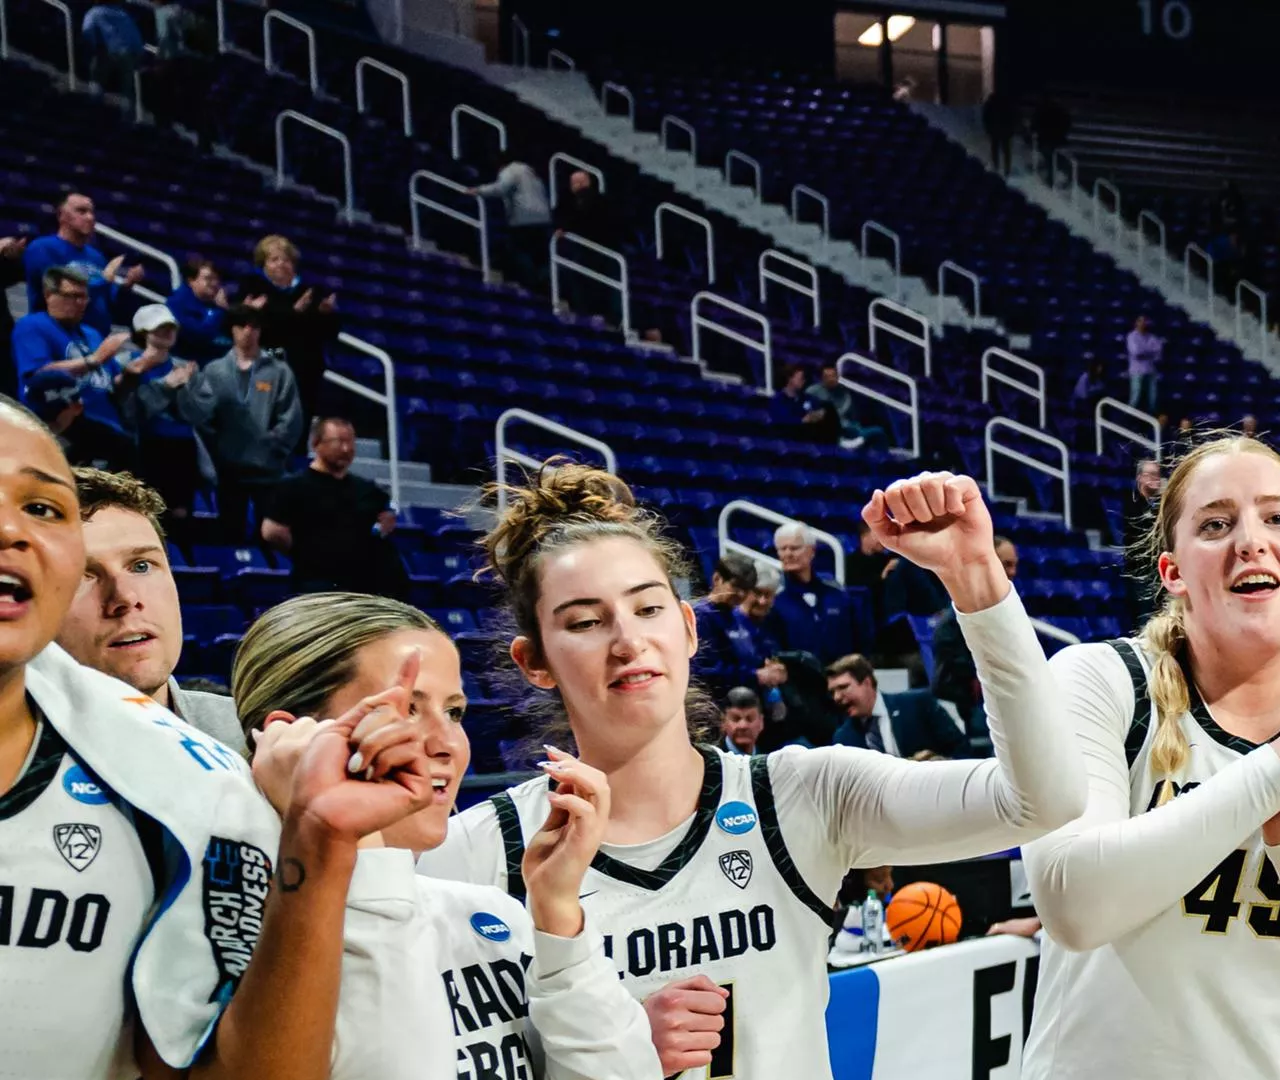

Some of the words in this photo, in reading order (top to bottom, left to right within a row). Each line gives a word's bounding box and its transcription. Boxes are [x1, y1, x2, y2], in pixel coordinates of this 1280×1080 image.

[1138, 0, 1192, 39] 10
[723, 815, 757, 829] NCAA
[66, 845, 88, 860] 12
[730, 865, 747, 881] 12
[209, 890, 252, 977] MARCH
